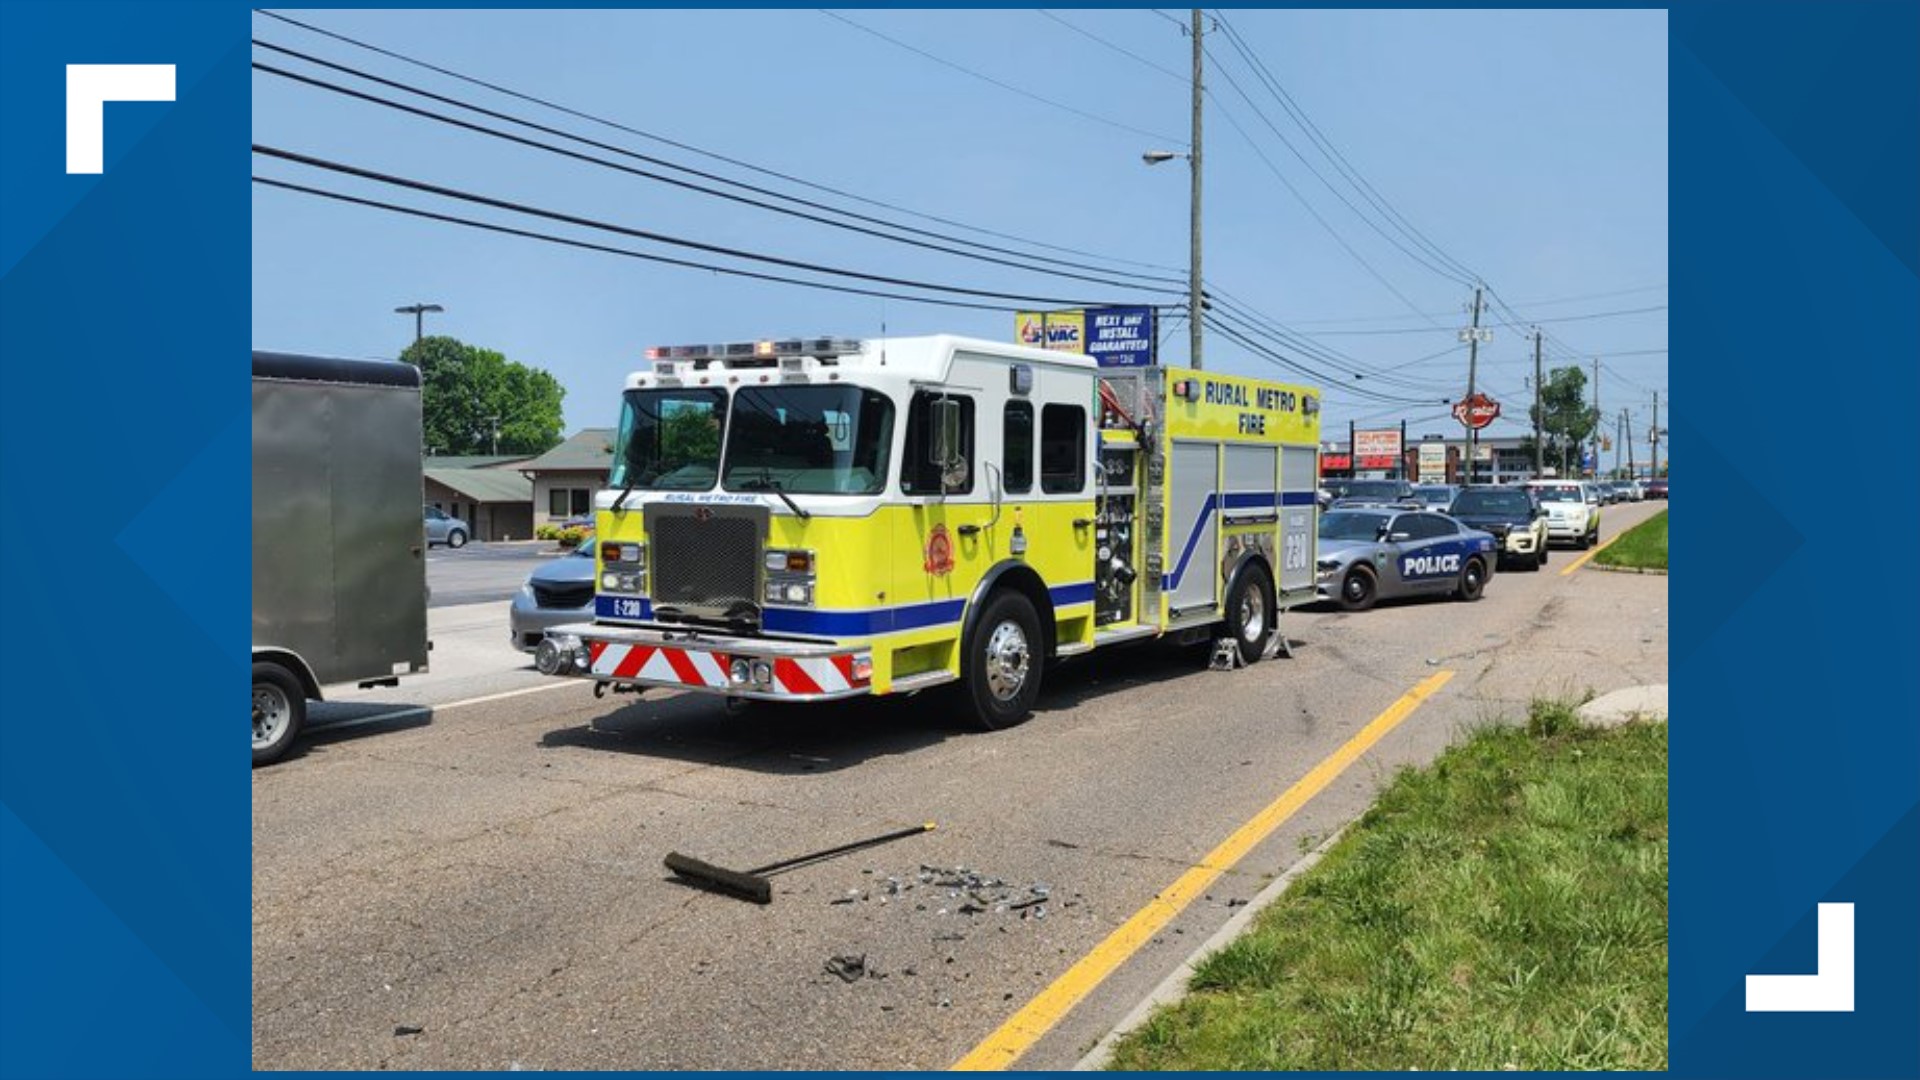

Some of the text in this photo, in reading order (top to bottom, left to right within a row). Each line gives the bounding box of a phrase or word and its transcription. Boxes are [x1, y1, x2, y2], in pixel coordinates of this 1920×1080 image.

[1099, 327, 1138, 339] INSTALL
[1089, 340, 1148, 352] GUARANTEED
[1205, 381, 1296, 412] RURAL METRO
[1238, 413, 1266, 435] FIRE
[1403, 554, 1460, 576] POLICE
[614, 599, 640, 616] E-230
